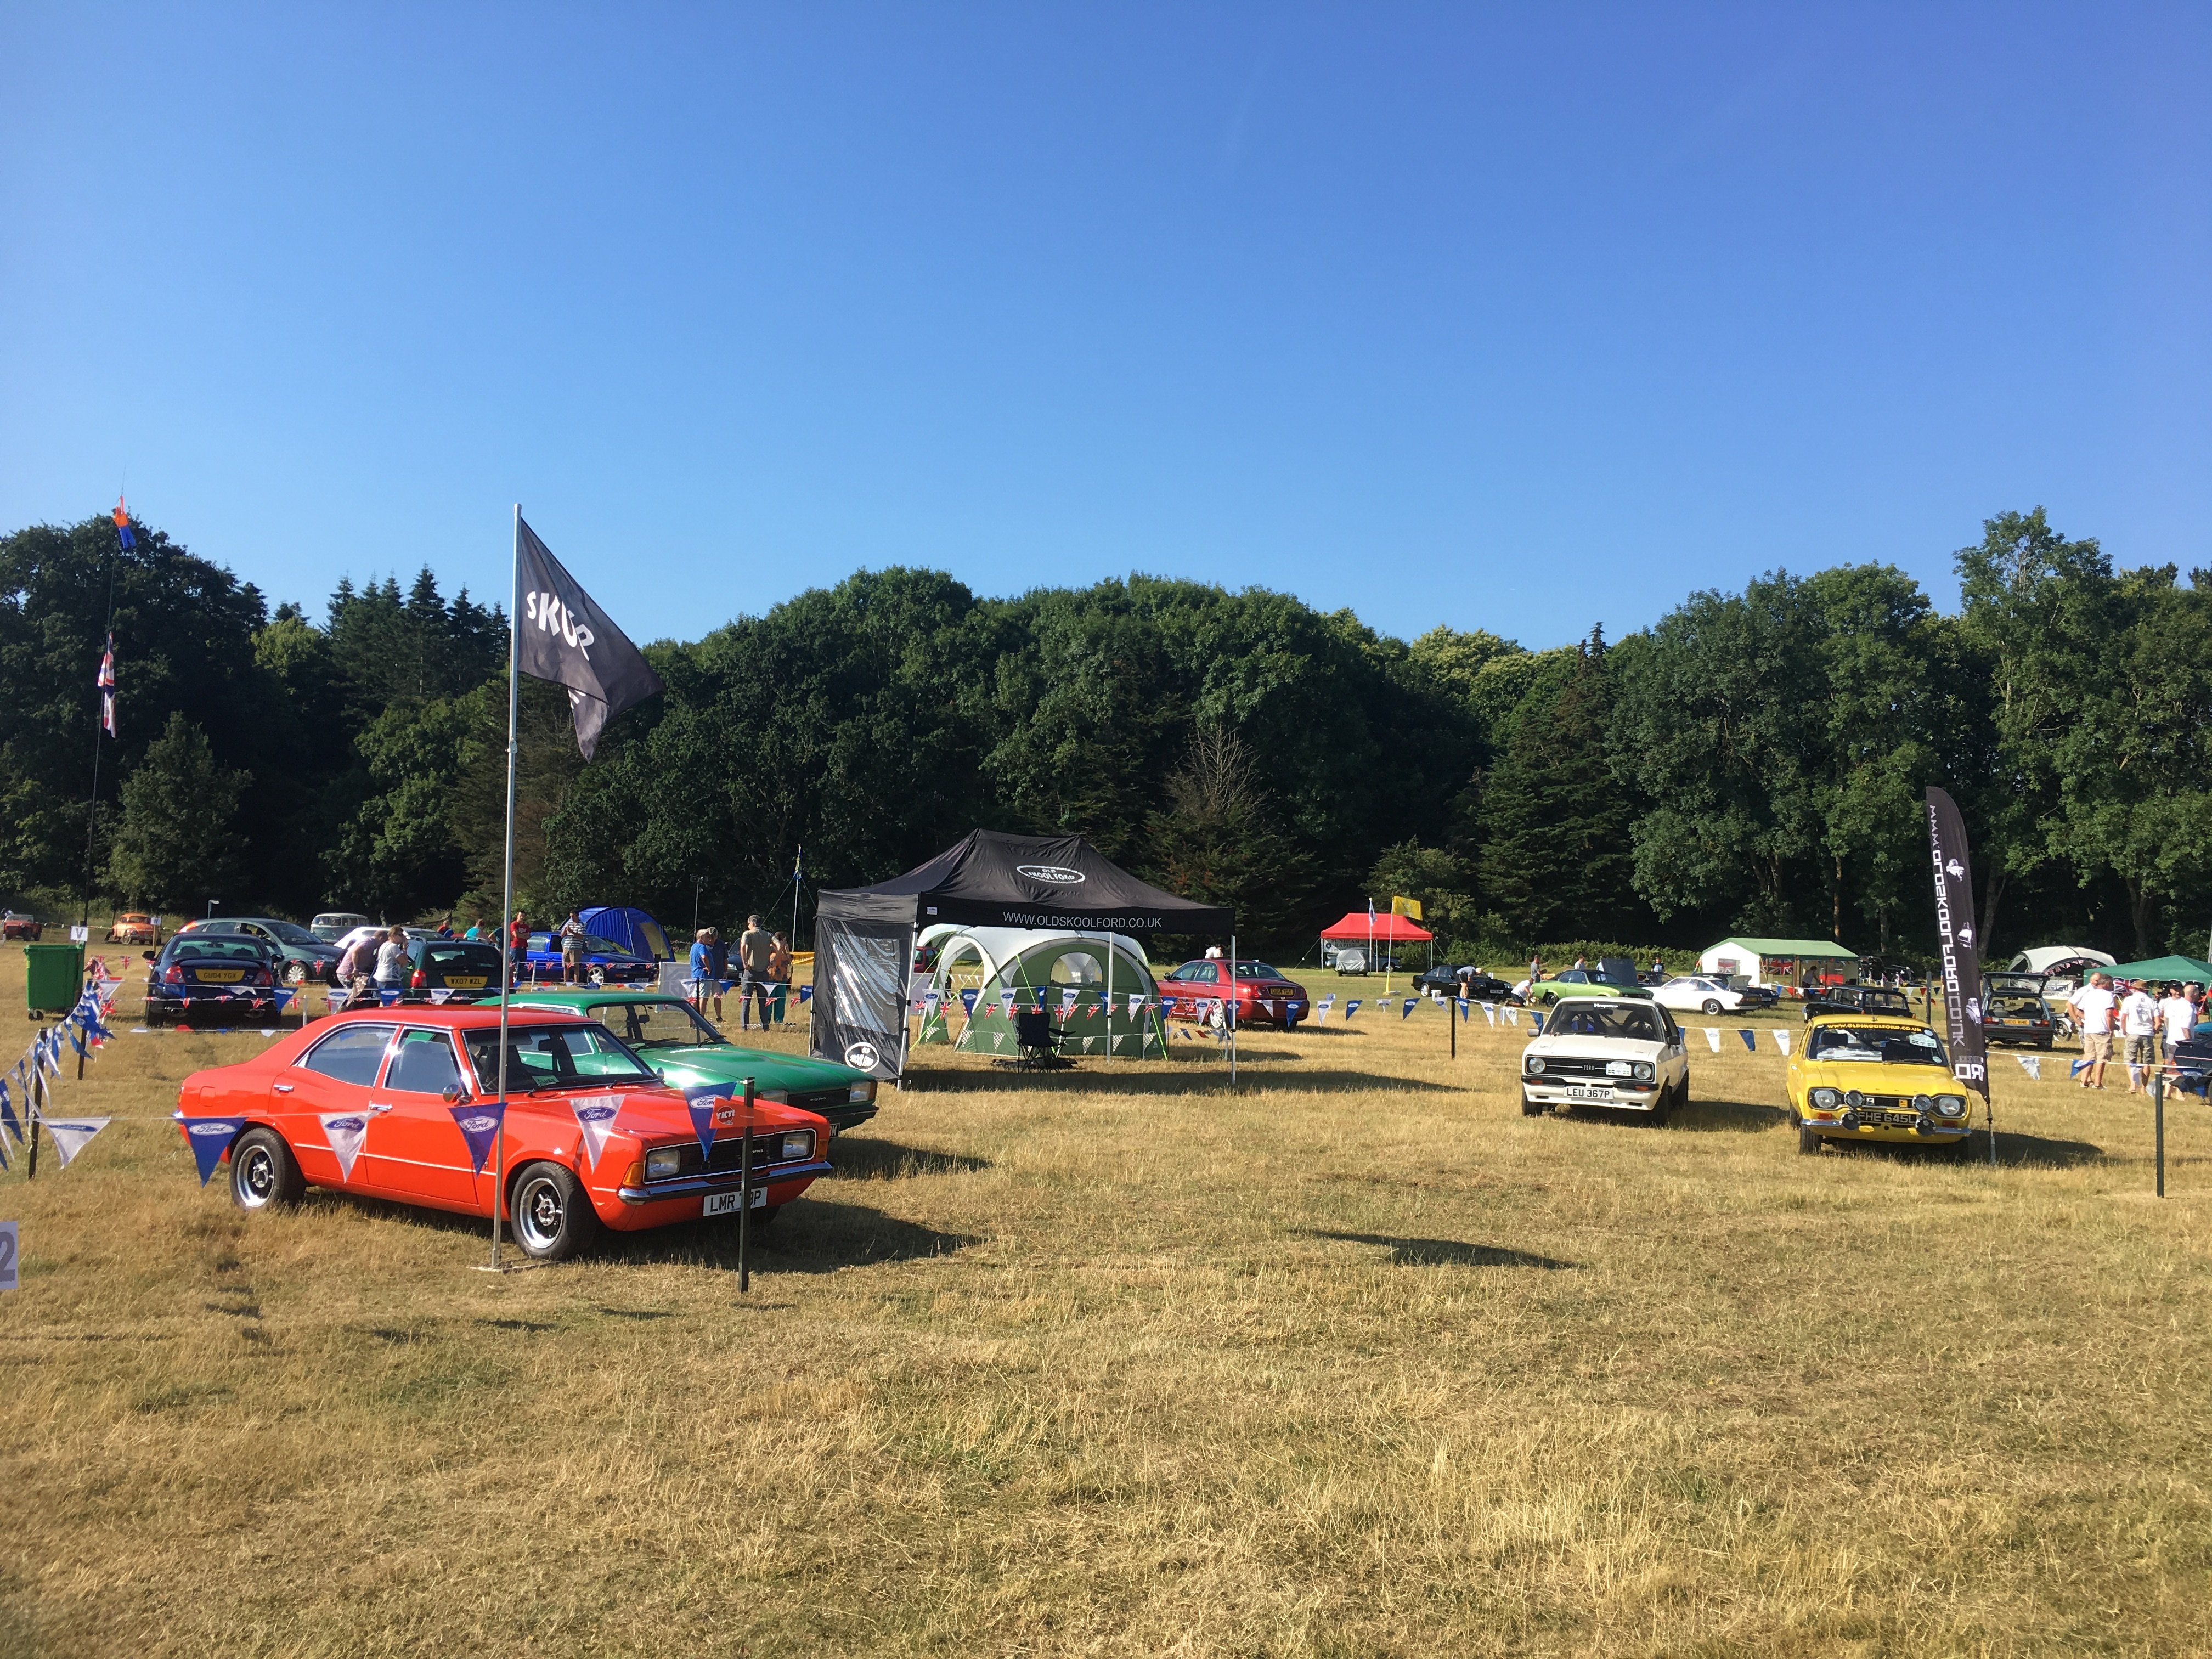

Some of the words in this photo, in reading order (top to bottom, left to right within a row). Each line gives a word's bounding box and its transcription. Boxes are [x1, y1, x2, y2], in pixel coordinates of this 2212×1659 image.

[1028, 871, 1054, 880] SKOOL
[1003, 912, 1161, 928] WWW.OLDSKOOLFORD.CO.UK
[75, 928, 84, 939] V
[1827, 1024, 1922, 1032] WWW.OLDSKOOLFORD.CO.UK
[1567, 1088, 1584, 1097] LEU
[1587, 1089, 1610, 1098] 367P
[584, 1108, 607, 1119] Ford
[1858, 1111, 1881, 1121] FHE
[1884, 1114, 1916, 1124] 645L
[197, 1123, 225, 1133] Ford
[334, 1118, 359, 1128] Ford
[466, 1118, 489, 1130] Ford
[710, 1194, 735, 1212] LMR
